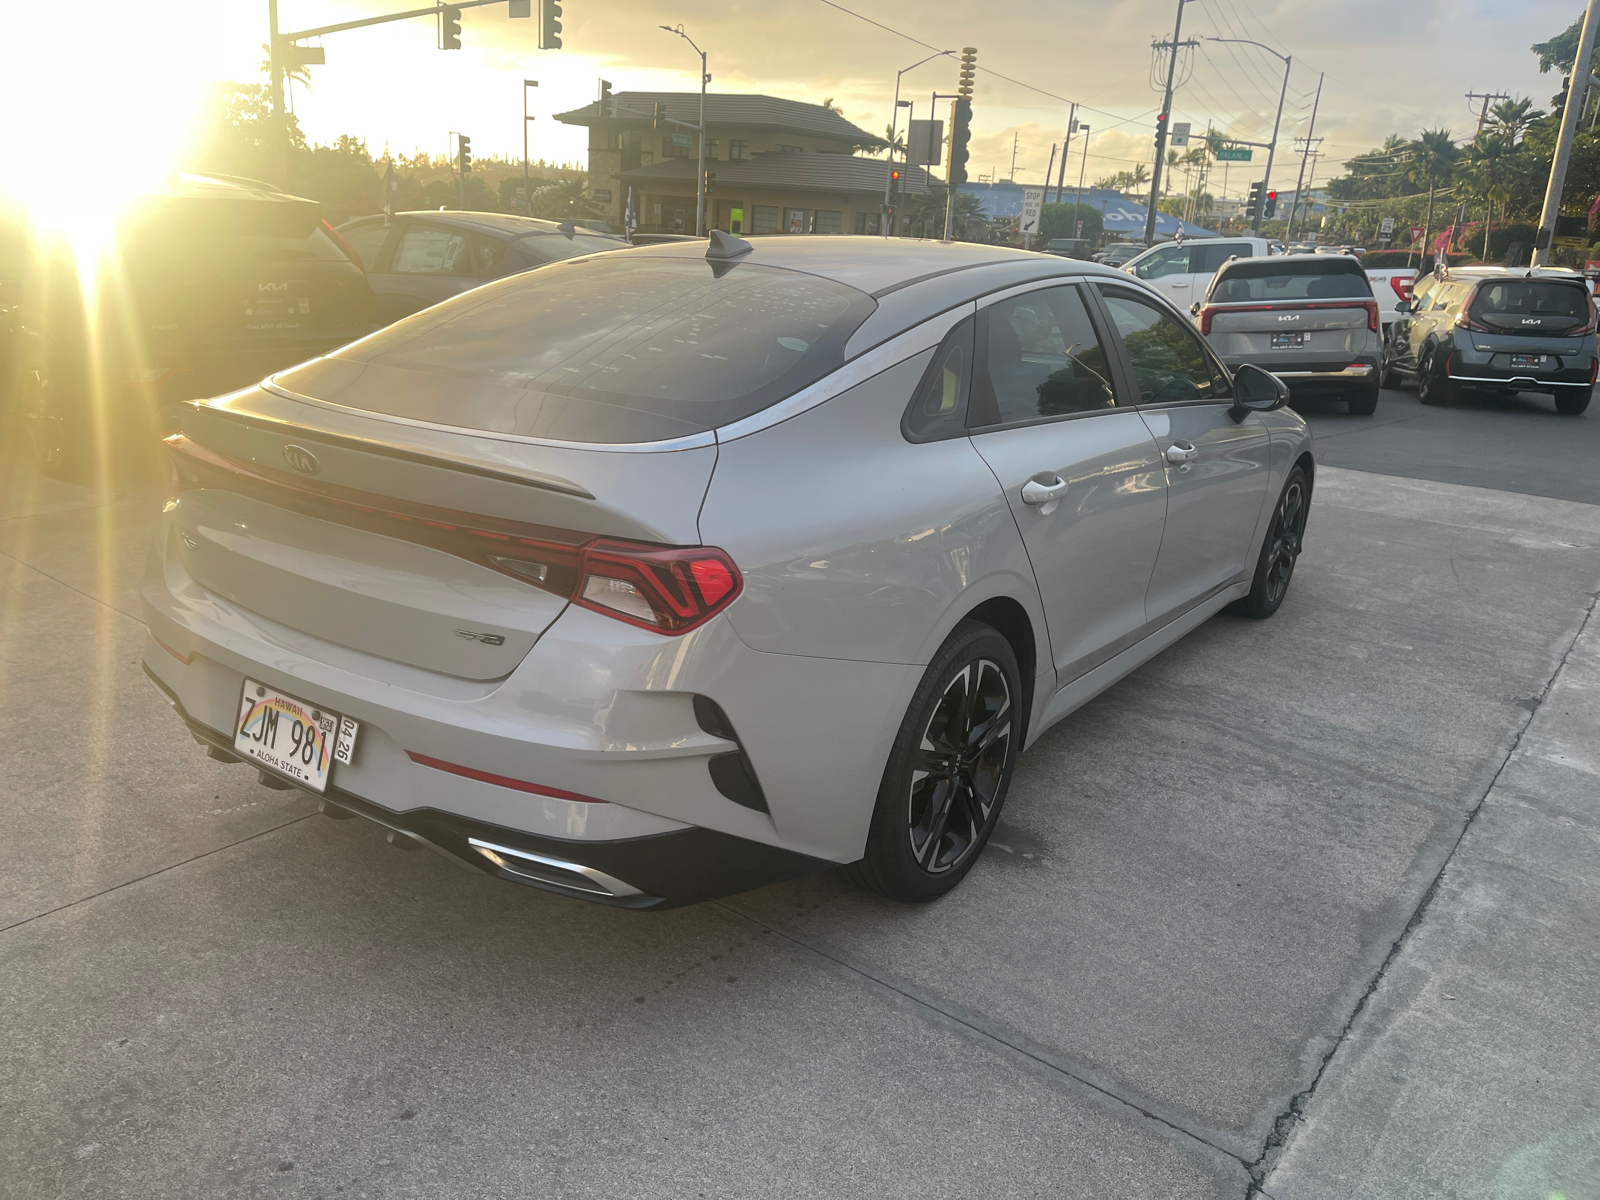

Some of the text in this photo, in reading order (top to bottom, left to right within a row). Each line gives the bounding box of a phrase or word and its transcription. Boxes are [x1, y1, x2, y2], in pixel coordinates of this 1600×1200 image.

[1026, 192, 1041, 200] STOP
[1025, 208, 1037, 217] RED
[258, 282, 288, 292] KIA
[275, 697, 303, 716] HAWAII
[240, 697, 327, 772] ZJM 981
[342, 719, 355, 738] 04
[337, 741, 350, 761] 26
[256, 749, 302, 778] ALOHA STATE
